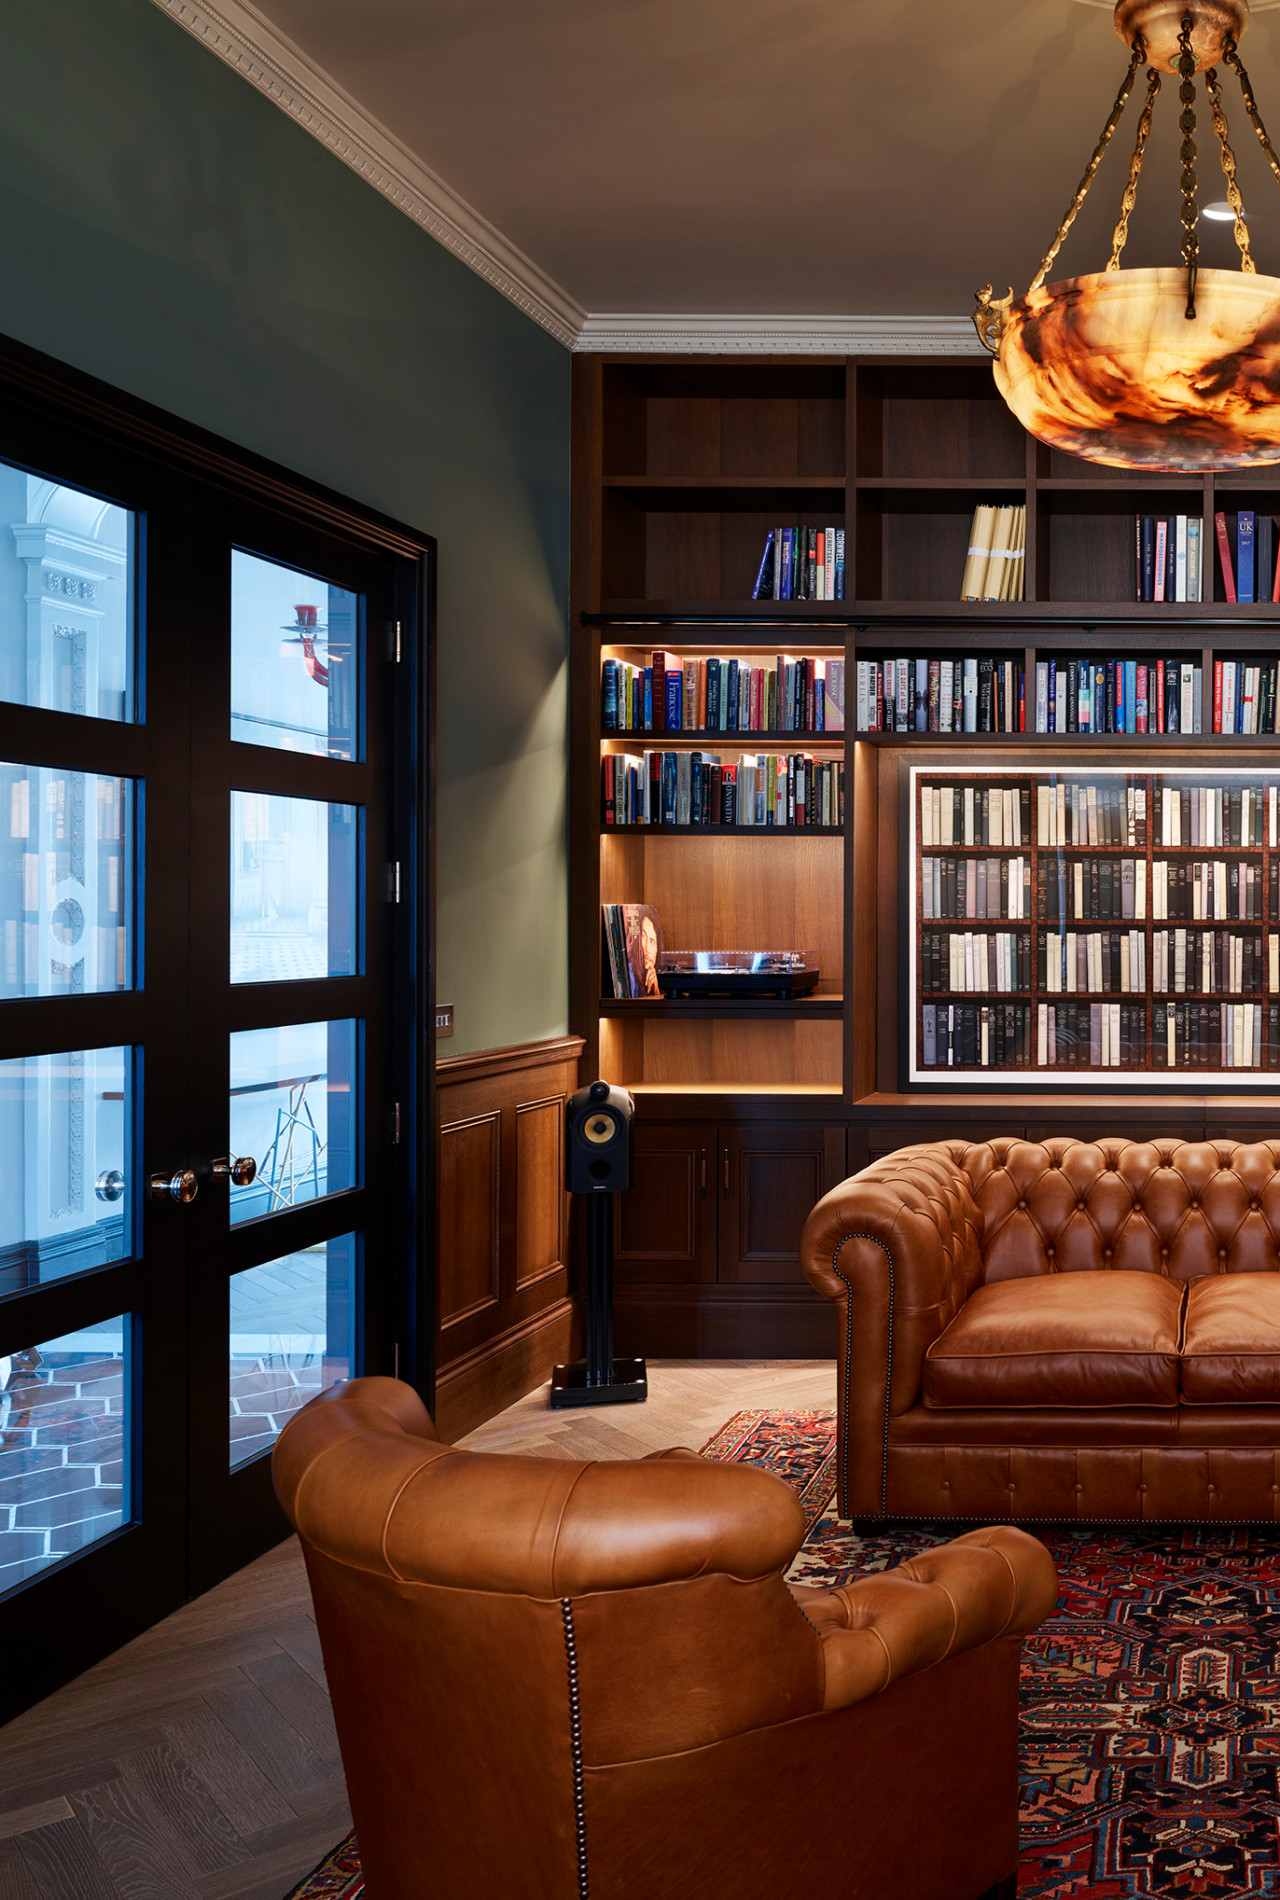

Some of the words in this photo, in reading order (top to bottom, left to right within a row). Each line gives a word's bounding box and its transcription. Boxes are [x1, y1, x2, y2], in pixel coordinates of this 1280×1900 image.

[836, 532, 845, 564] CORNWELL
[870, 666, 876, 674] MO
[668, 682, 679, 720] Francese
[725, 773, 734, 782] R
